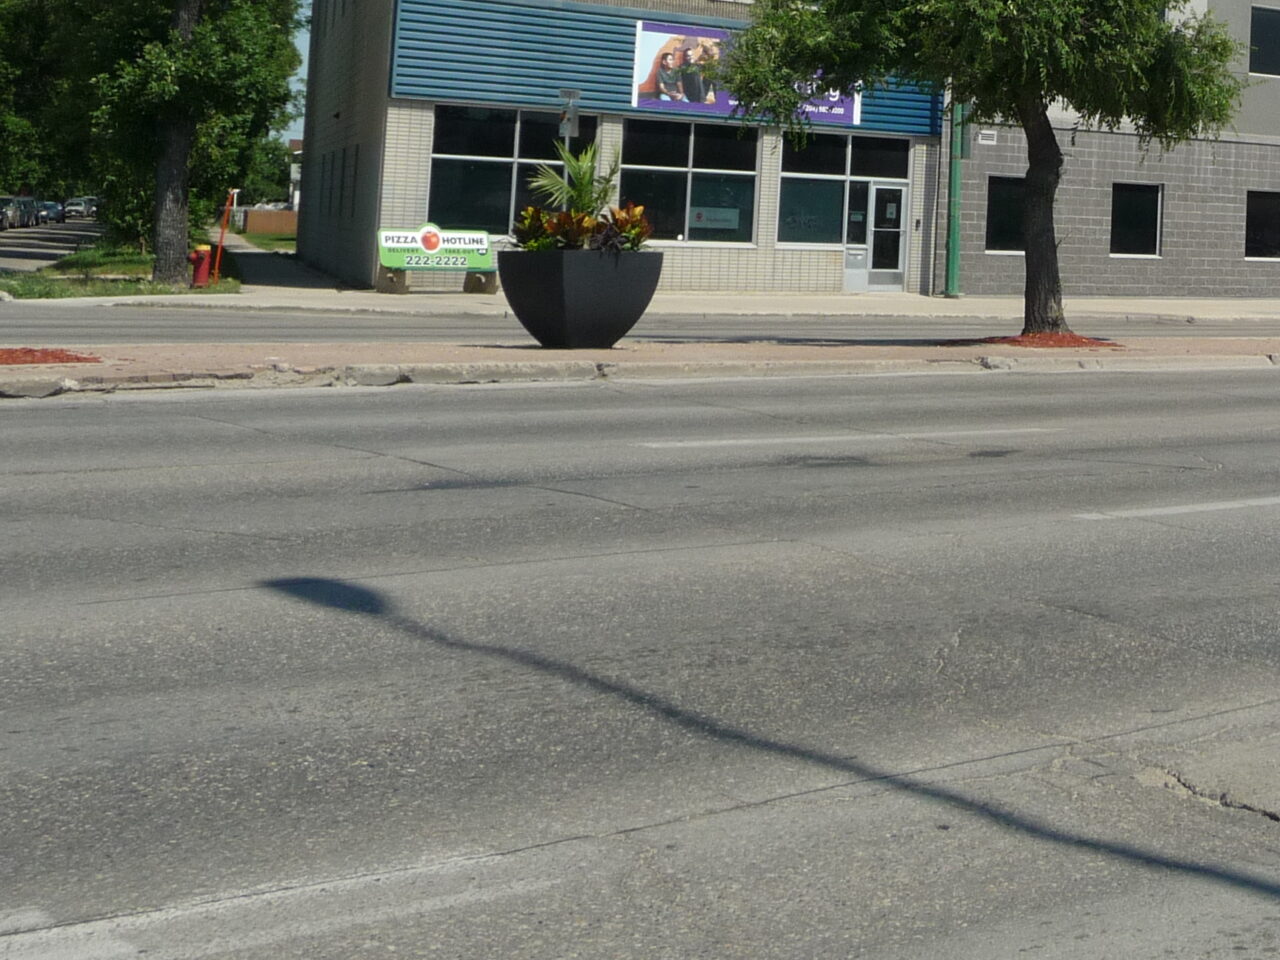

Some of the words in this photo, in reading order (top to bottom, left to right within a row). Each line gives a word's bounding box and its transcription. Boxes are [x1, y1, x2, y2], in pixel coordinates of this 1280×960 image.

[385, 235, 418, 244] PIZZA
[442, 236, 485, 245] HOTLINE
[405, 256, 467, 266] 222-2222
